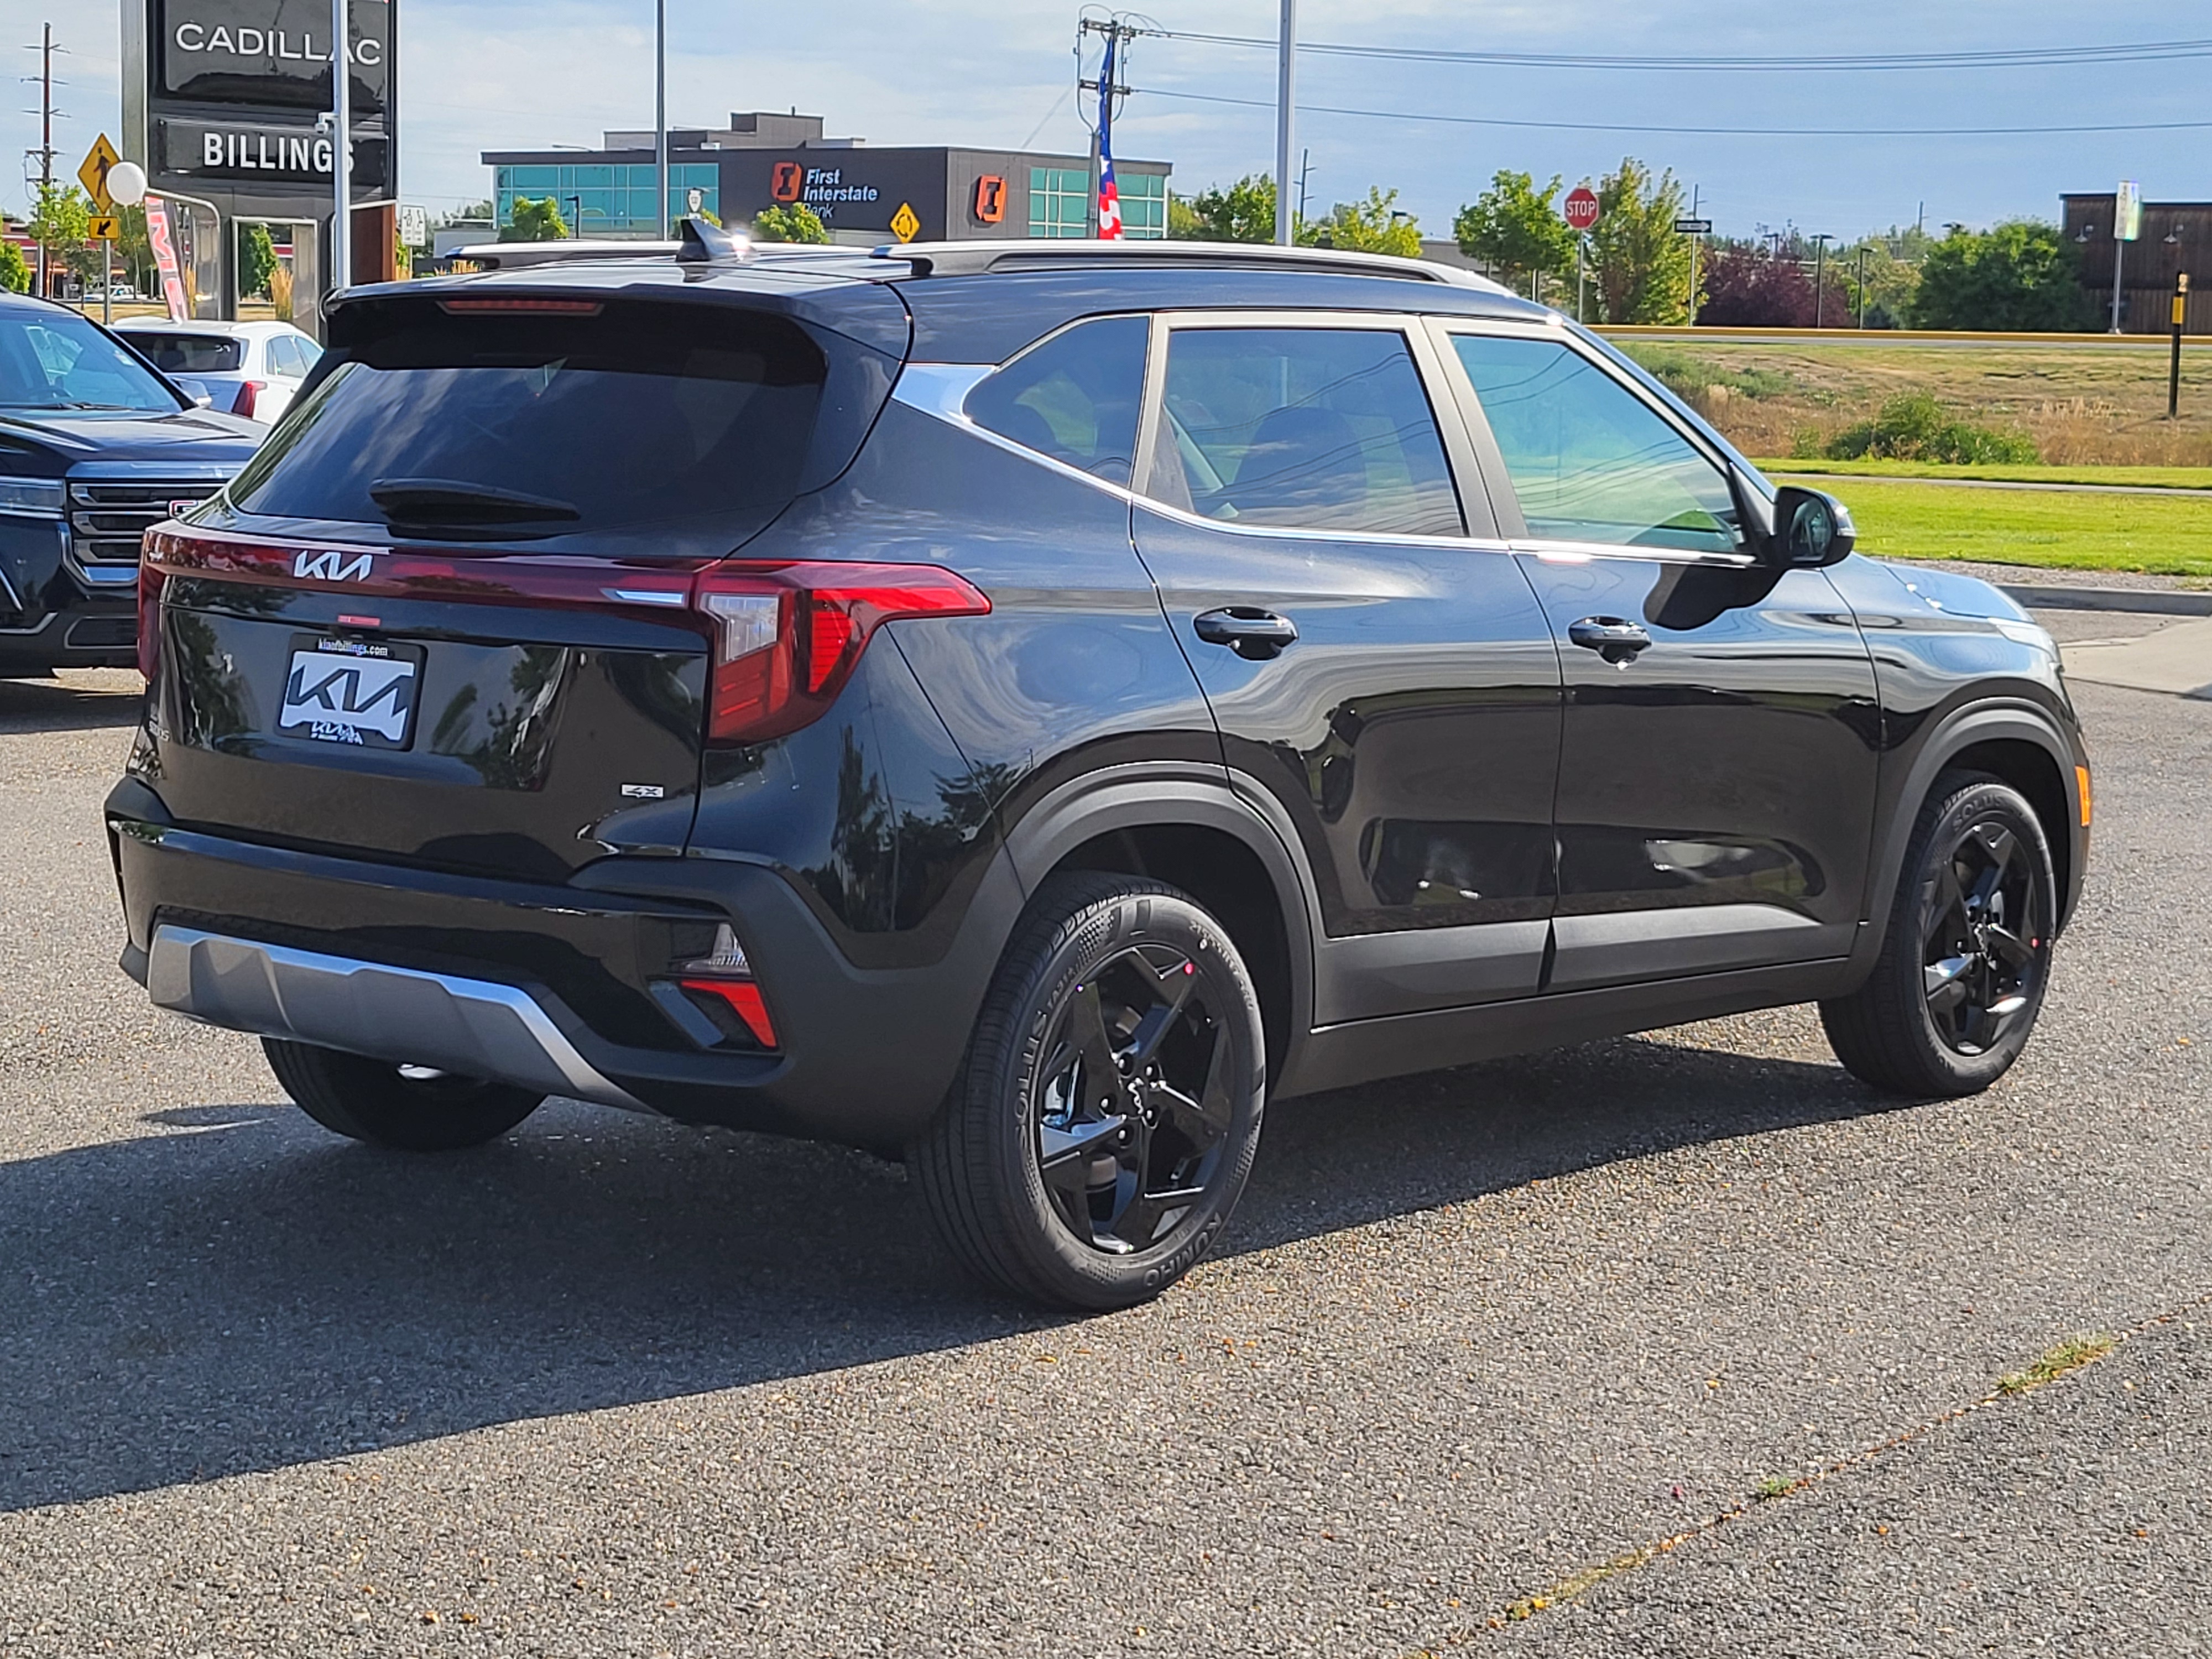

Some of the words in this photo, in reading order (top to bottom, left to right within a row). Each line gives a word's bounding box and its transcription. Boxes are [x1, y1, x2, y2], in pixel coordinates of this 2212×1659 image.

[806, 168, 841, 184] First
[803, 186, 878, 202] Interstate
[1566, 200, 1596, 216] STOP
[294, 550, 374, 582] KIA
[286, 664, 415, 718] KIA
[1144, 1212, 1222, 1287] KUMHO
